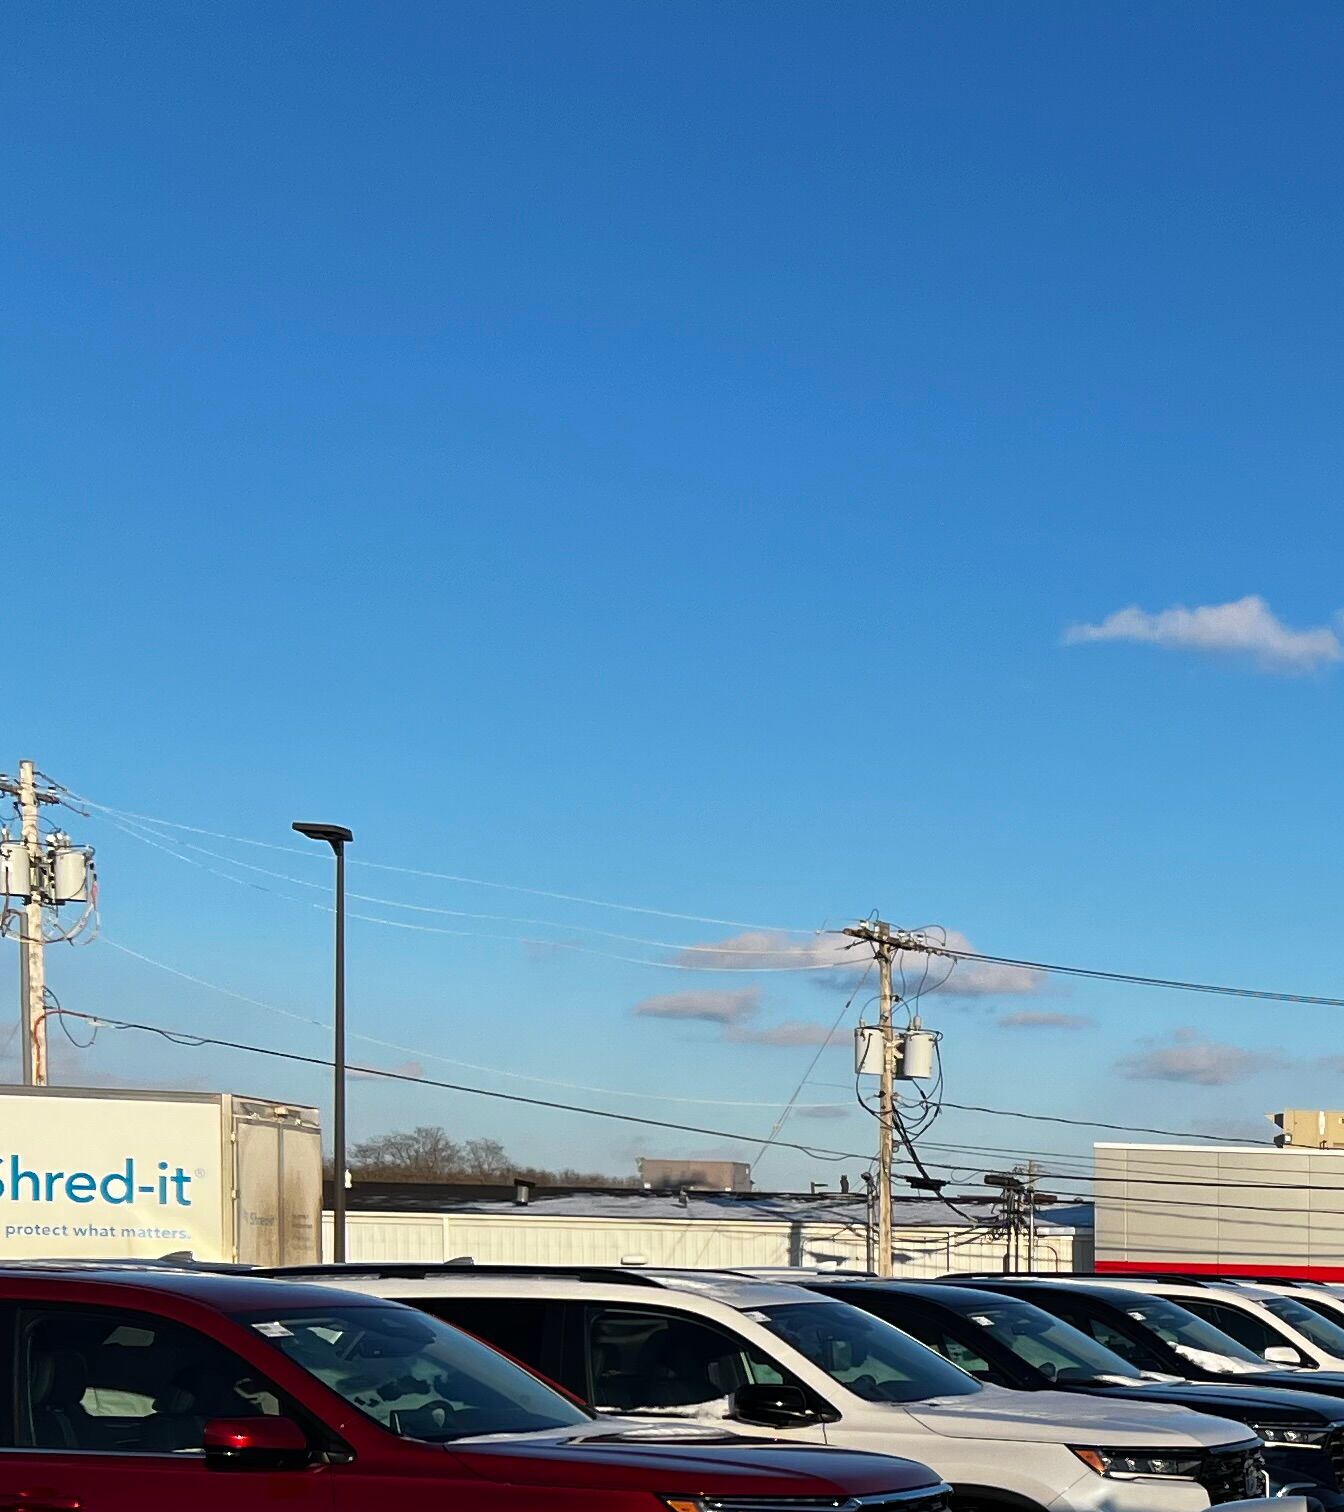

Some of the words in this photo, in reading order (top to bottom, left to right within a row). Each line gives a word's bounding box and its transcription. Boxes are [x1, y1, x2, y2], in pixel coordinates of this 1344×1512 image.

[0, 1155, 192, 1207] hred-it
[5, 1224, 69, 1239] protect
[73, 1224, 116, 1238] what
[121, 1226, 192, 1240] matters.
